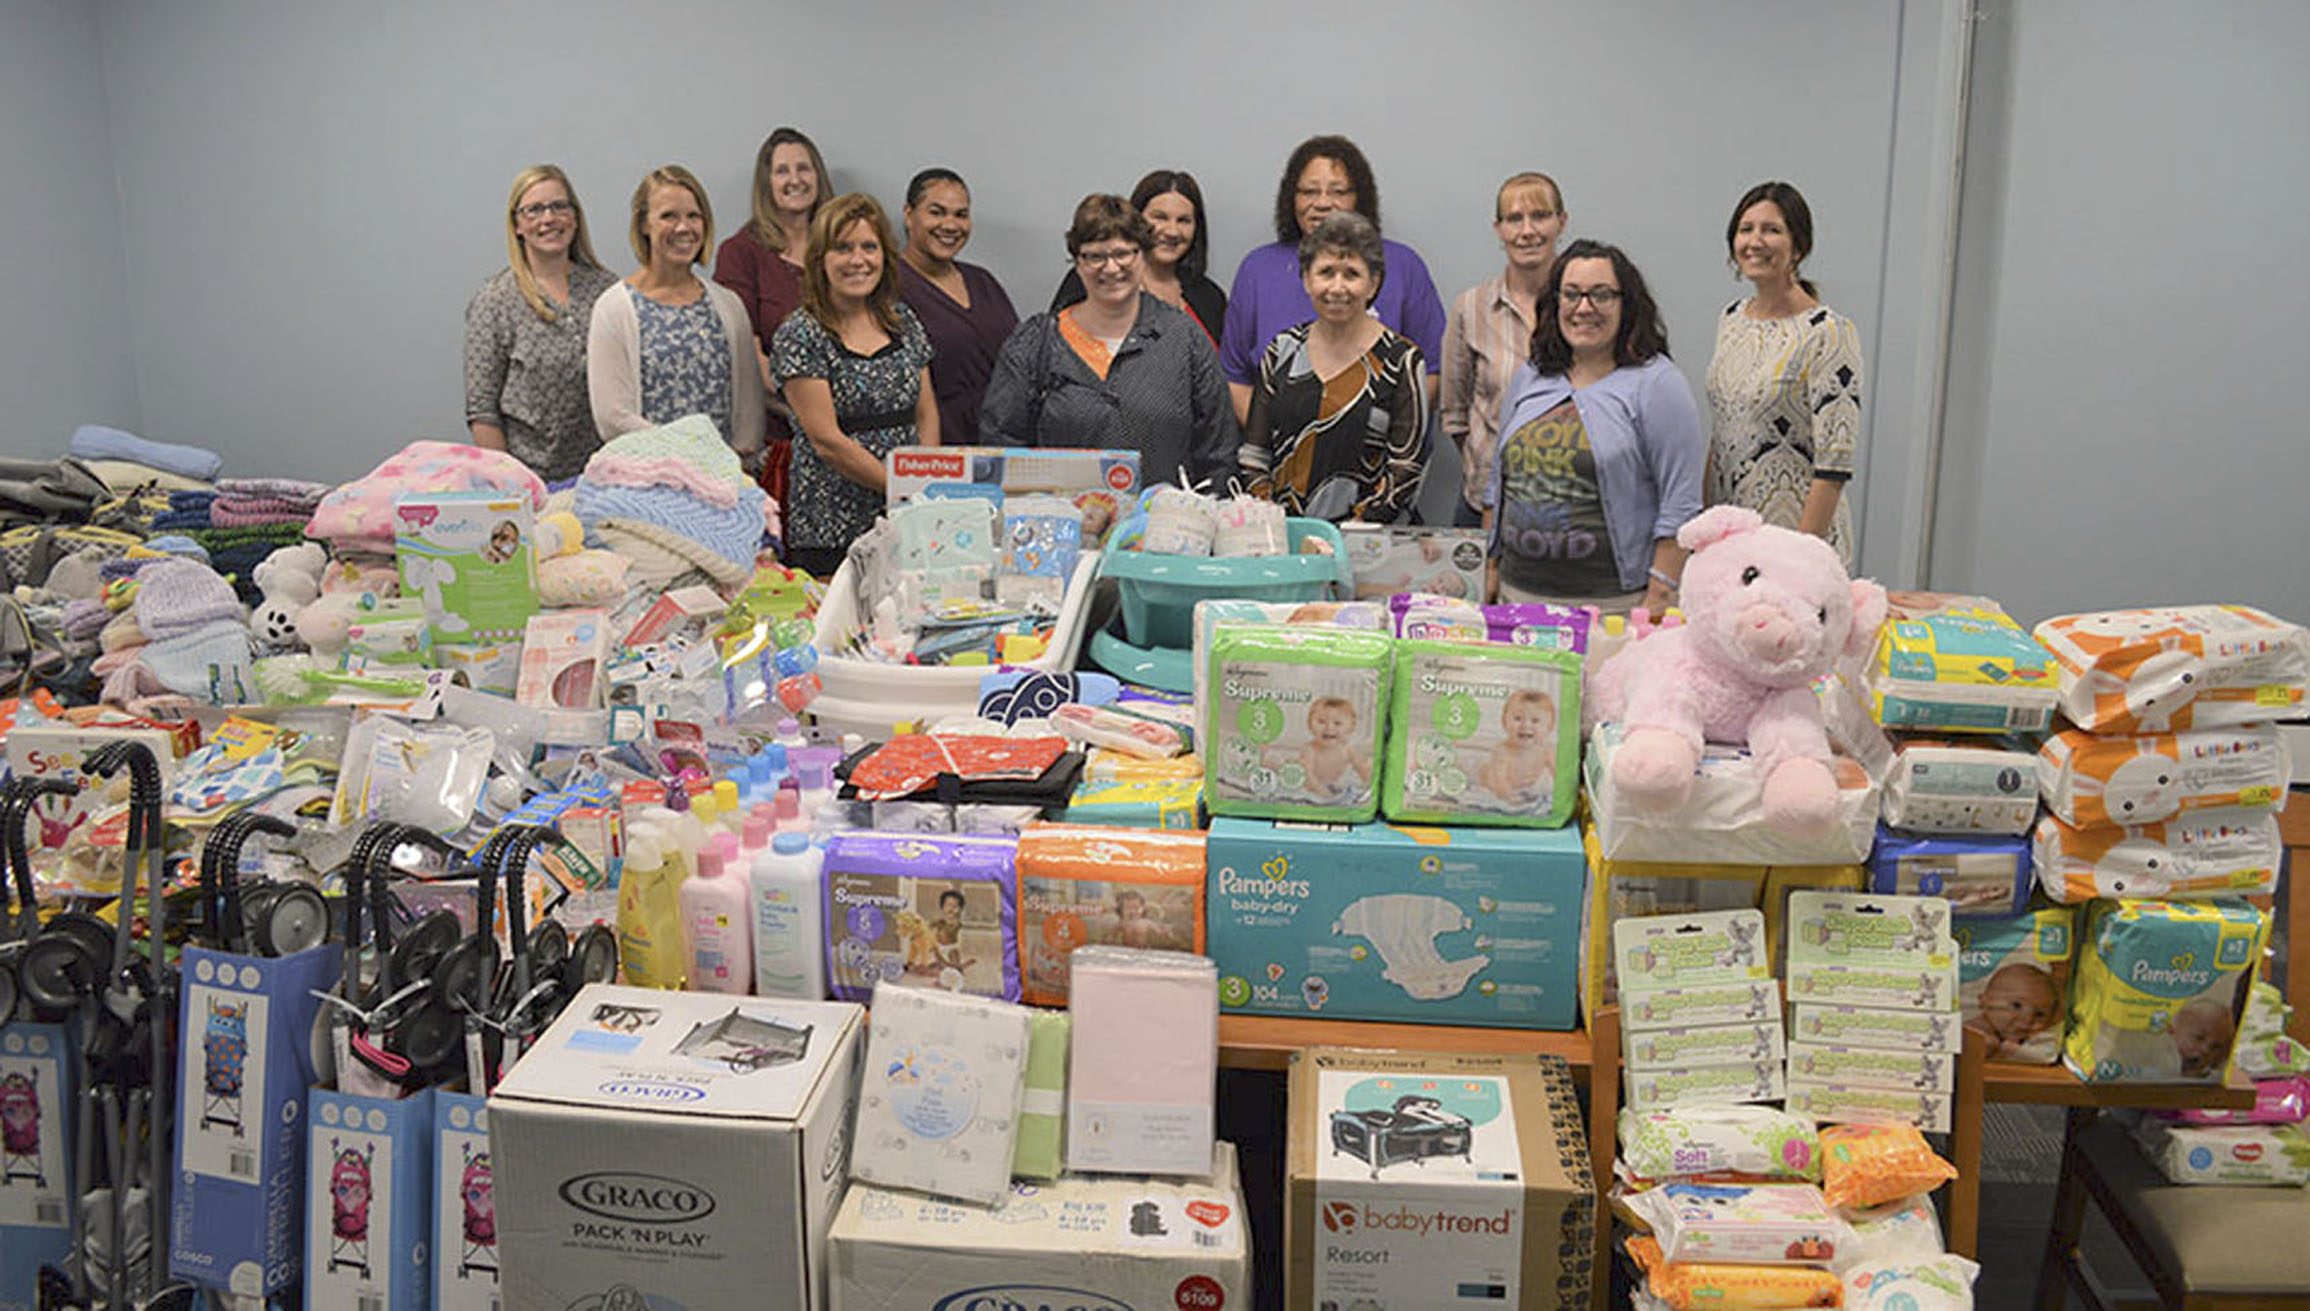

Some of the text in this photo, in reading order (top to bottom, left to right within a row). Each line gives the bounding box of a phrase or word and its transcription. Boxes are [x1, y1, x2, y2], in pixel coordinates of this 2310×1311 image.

[1225, 679, 1313, 704] Supreme
[1420, 674, 1510, 701] Supreme
[1449, 706, 1463, 726] 3
[1218, 865, 1310, 900] Pampers
[1231, 898, 1299, 915] baby-dry
[2131, 958, 2210, 986] Pampers
[1226, 976, 1243, 999] 3
[1674, 1149, 1708, 1164] Soft
[581, 1181, 699, 1213] GRACO
[1364, 1203, 1511, 1238] babytrend
[573, 1223, 625, 1242] PACK
[655, 1231, 708, 1248] PLAY
[1326, 1246, 1390, 1265] Resort
